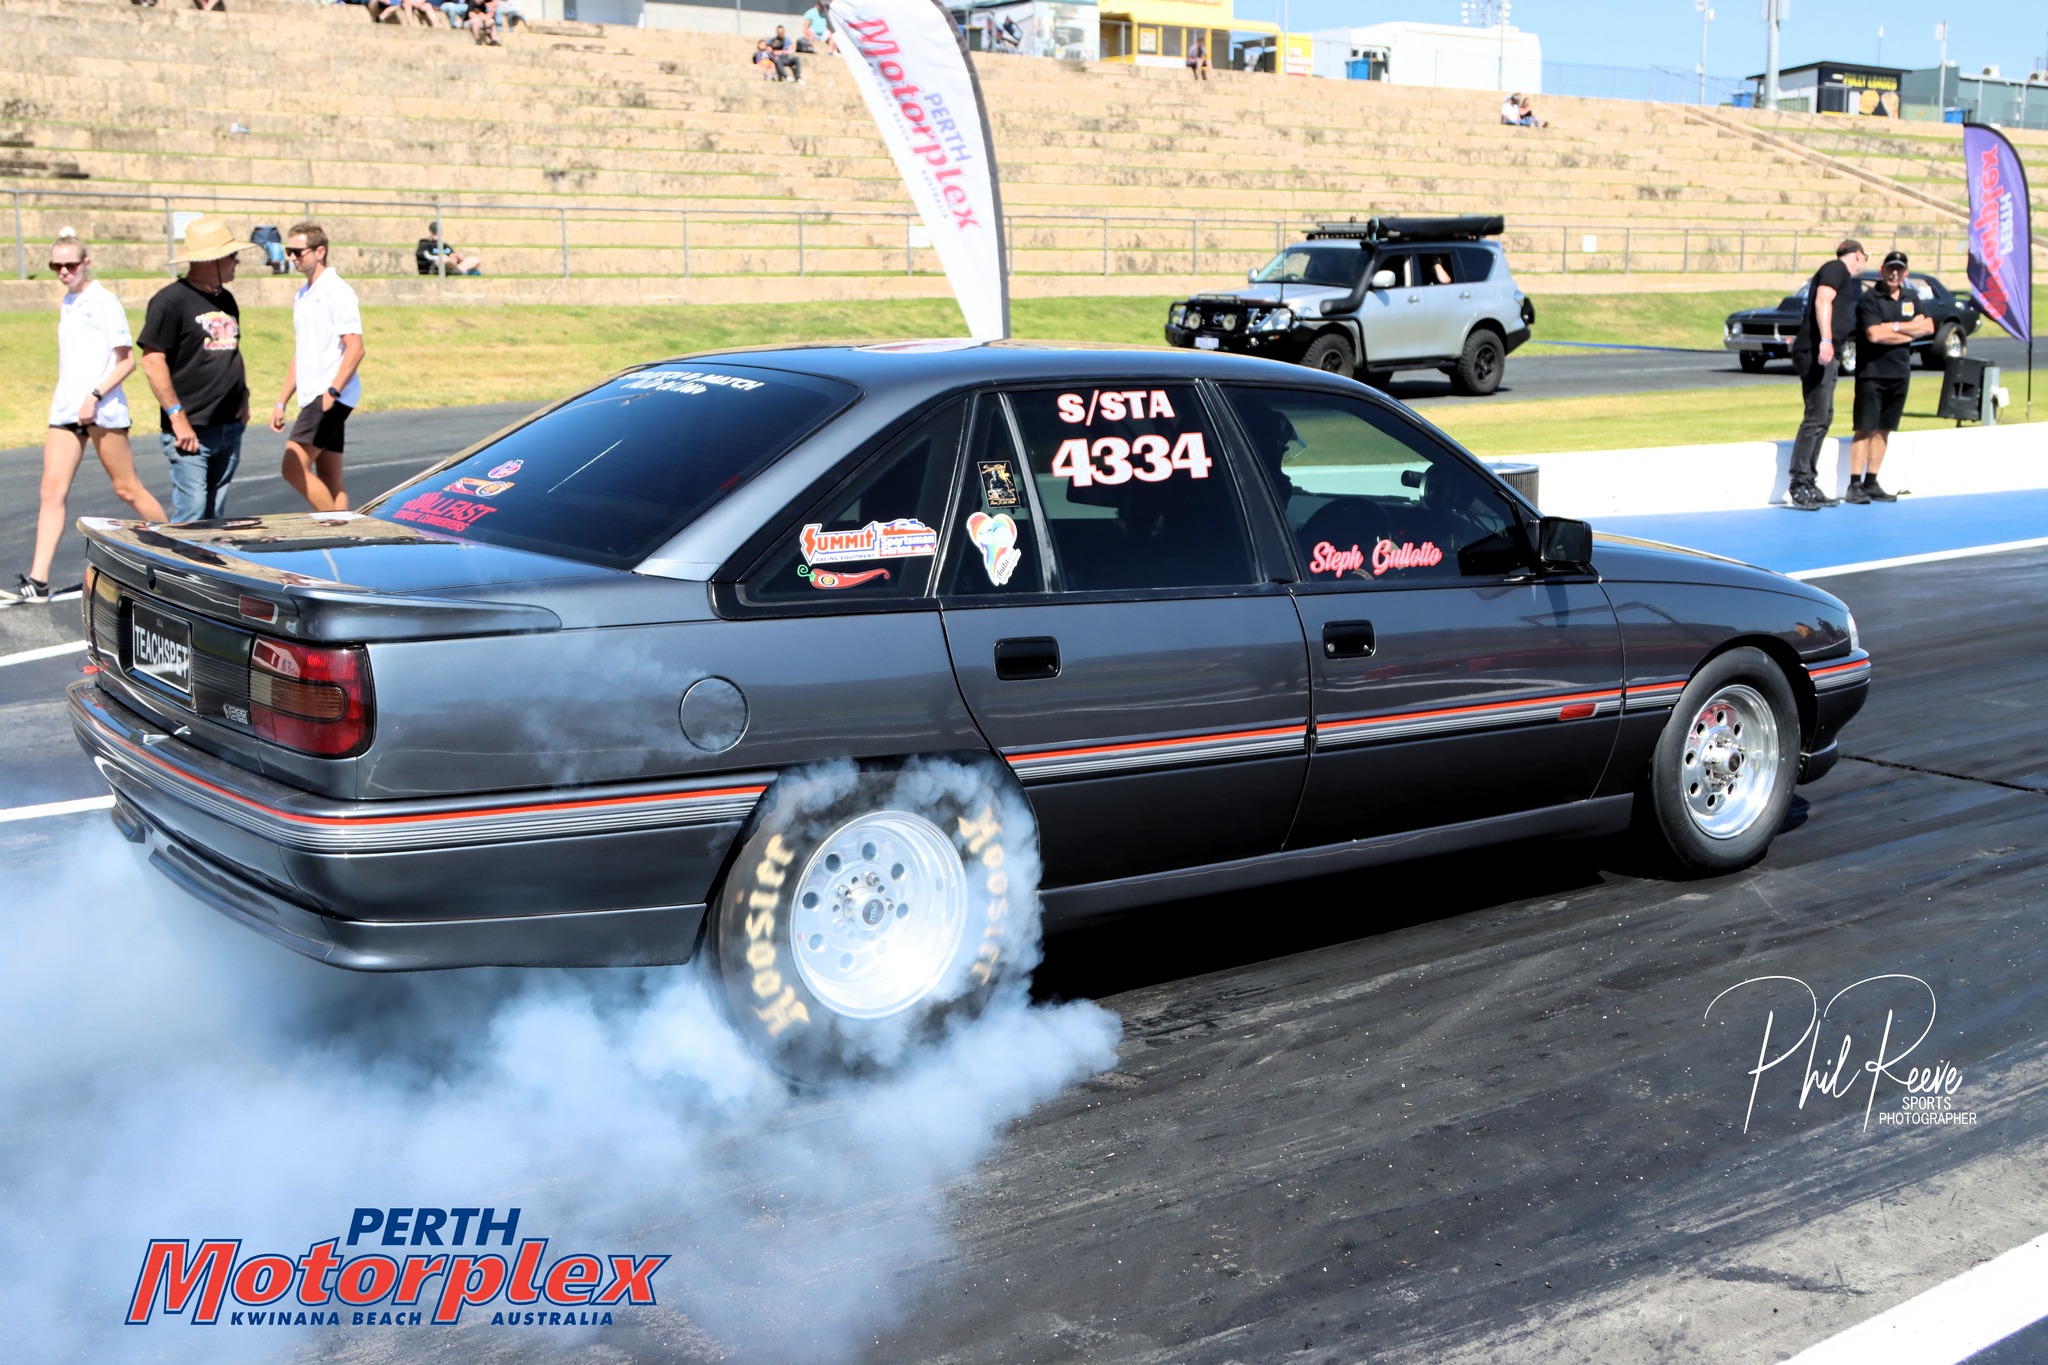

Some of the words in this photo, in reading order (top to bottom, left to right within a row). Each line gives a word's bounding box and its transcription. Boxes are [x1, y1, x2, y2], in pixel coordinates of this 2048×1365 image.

[845, 17, 982, 231] Motorplex
[924, 92, 972, 162] PERTH
[1057, 389, 1175, 426] S/STA
[1051, 432, 1212, 488] 4334
[803, 527, 874, 558] SUMMIT
[881, 535, 935, 548] Sportsman
[1310, 541, 1364, 578] Steph
[1372, 539, 1443, 576] Gullotto
[135, 625, 189, 679] TEACHSPET
